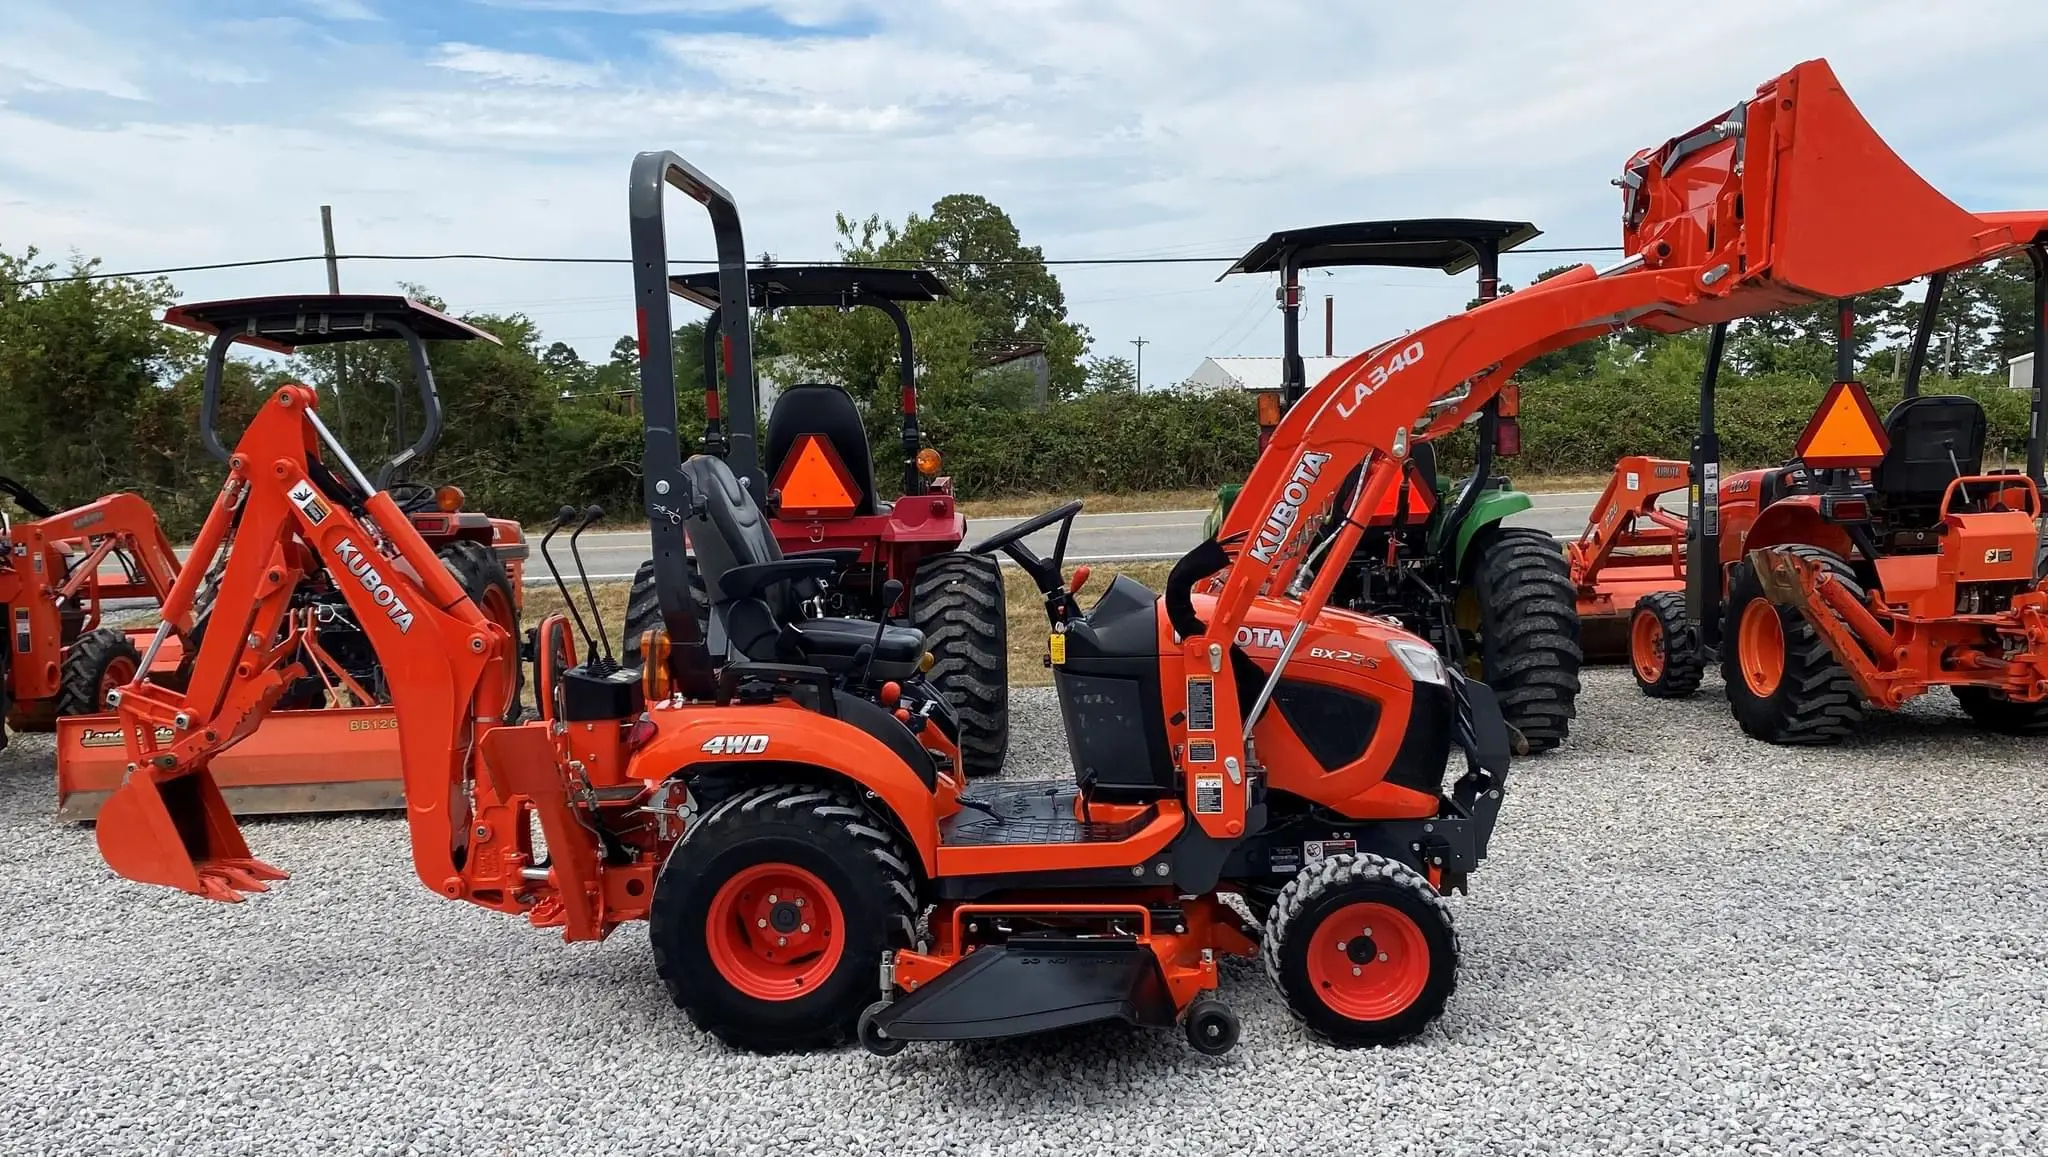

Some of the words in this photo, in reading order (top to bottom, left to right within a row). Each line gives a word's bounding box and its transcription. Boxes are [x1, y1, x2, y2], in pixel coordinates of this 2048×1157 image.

[1336, 341, 1424, 418] LA340
[1248, 450, 1330, 565] KUBOTA
[334, 537, 414, 634] KUBOTA
[1310, 647, 1382, 669] BX23S
[349, 718, 399, 732] BB126
[700, 735, 769, 755] 4WD
